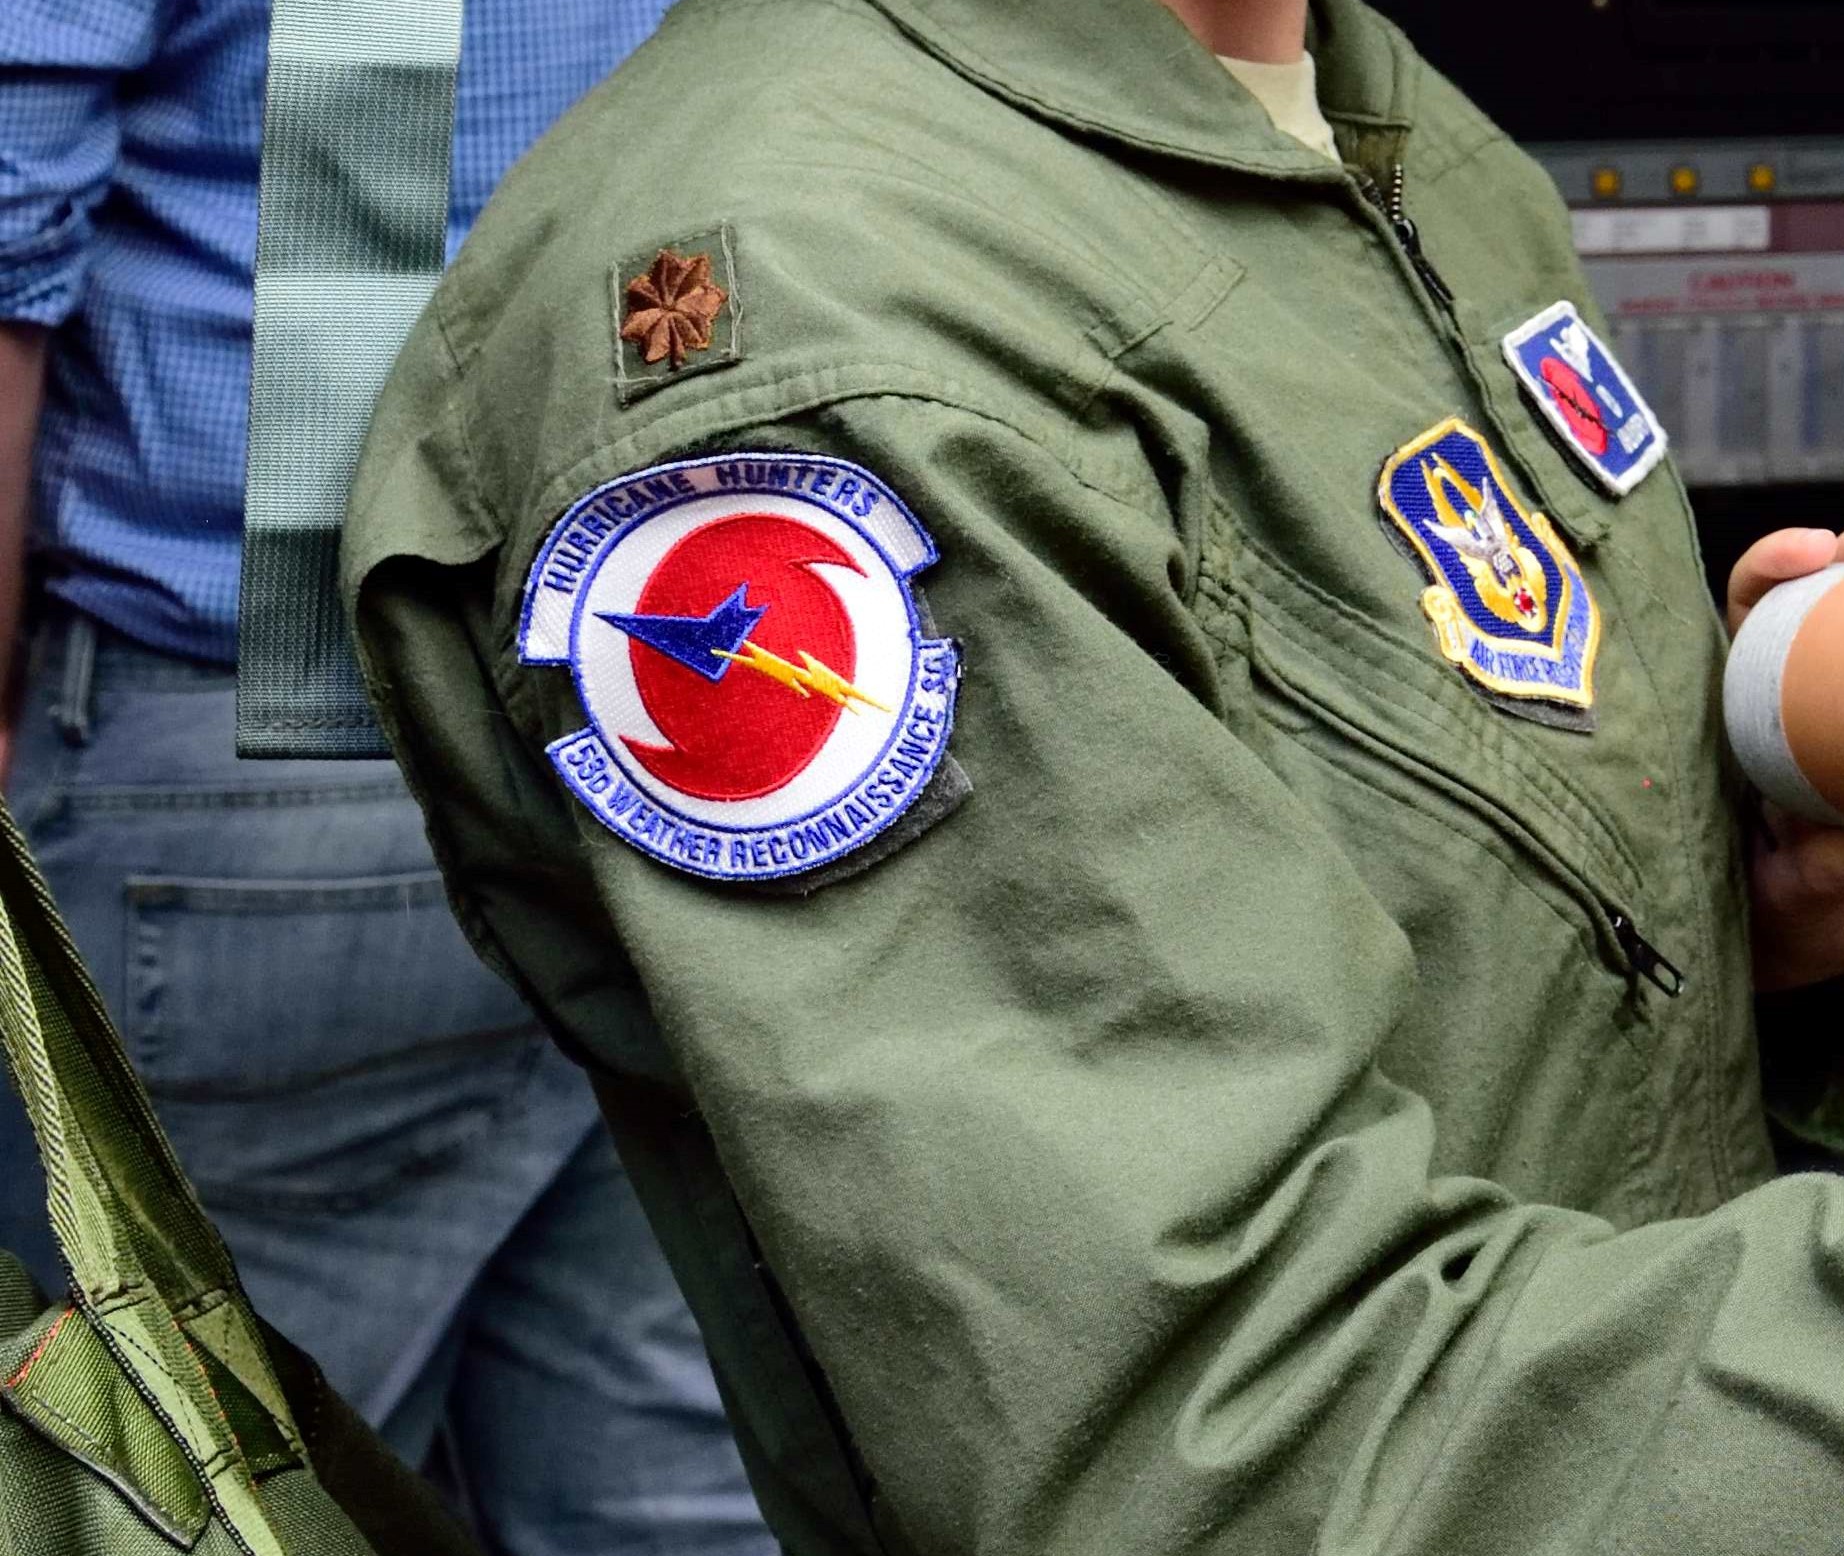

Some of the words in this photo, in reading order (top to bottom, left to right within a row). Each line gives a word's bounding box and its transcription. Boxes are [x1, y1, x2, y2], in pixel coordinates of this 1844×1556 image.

[543, 472, 696, 595] HURRICANE
[715, 463, 880, 517] HUNTERS
[606, 781, 723, 865] WEATHER
[730, 704, 944, 869] RECONNAISSANCE
